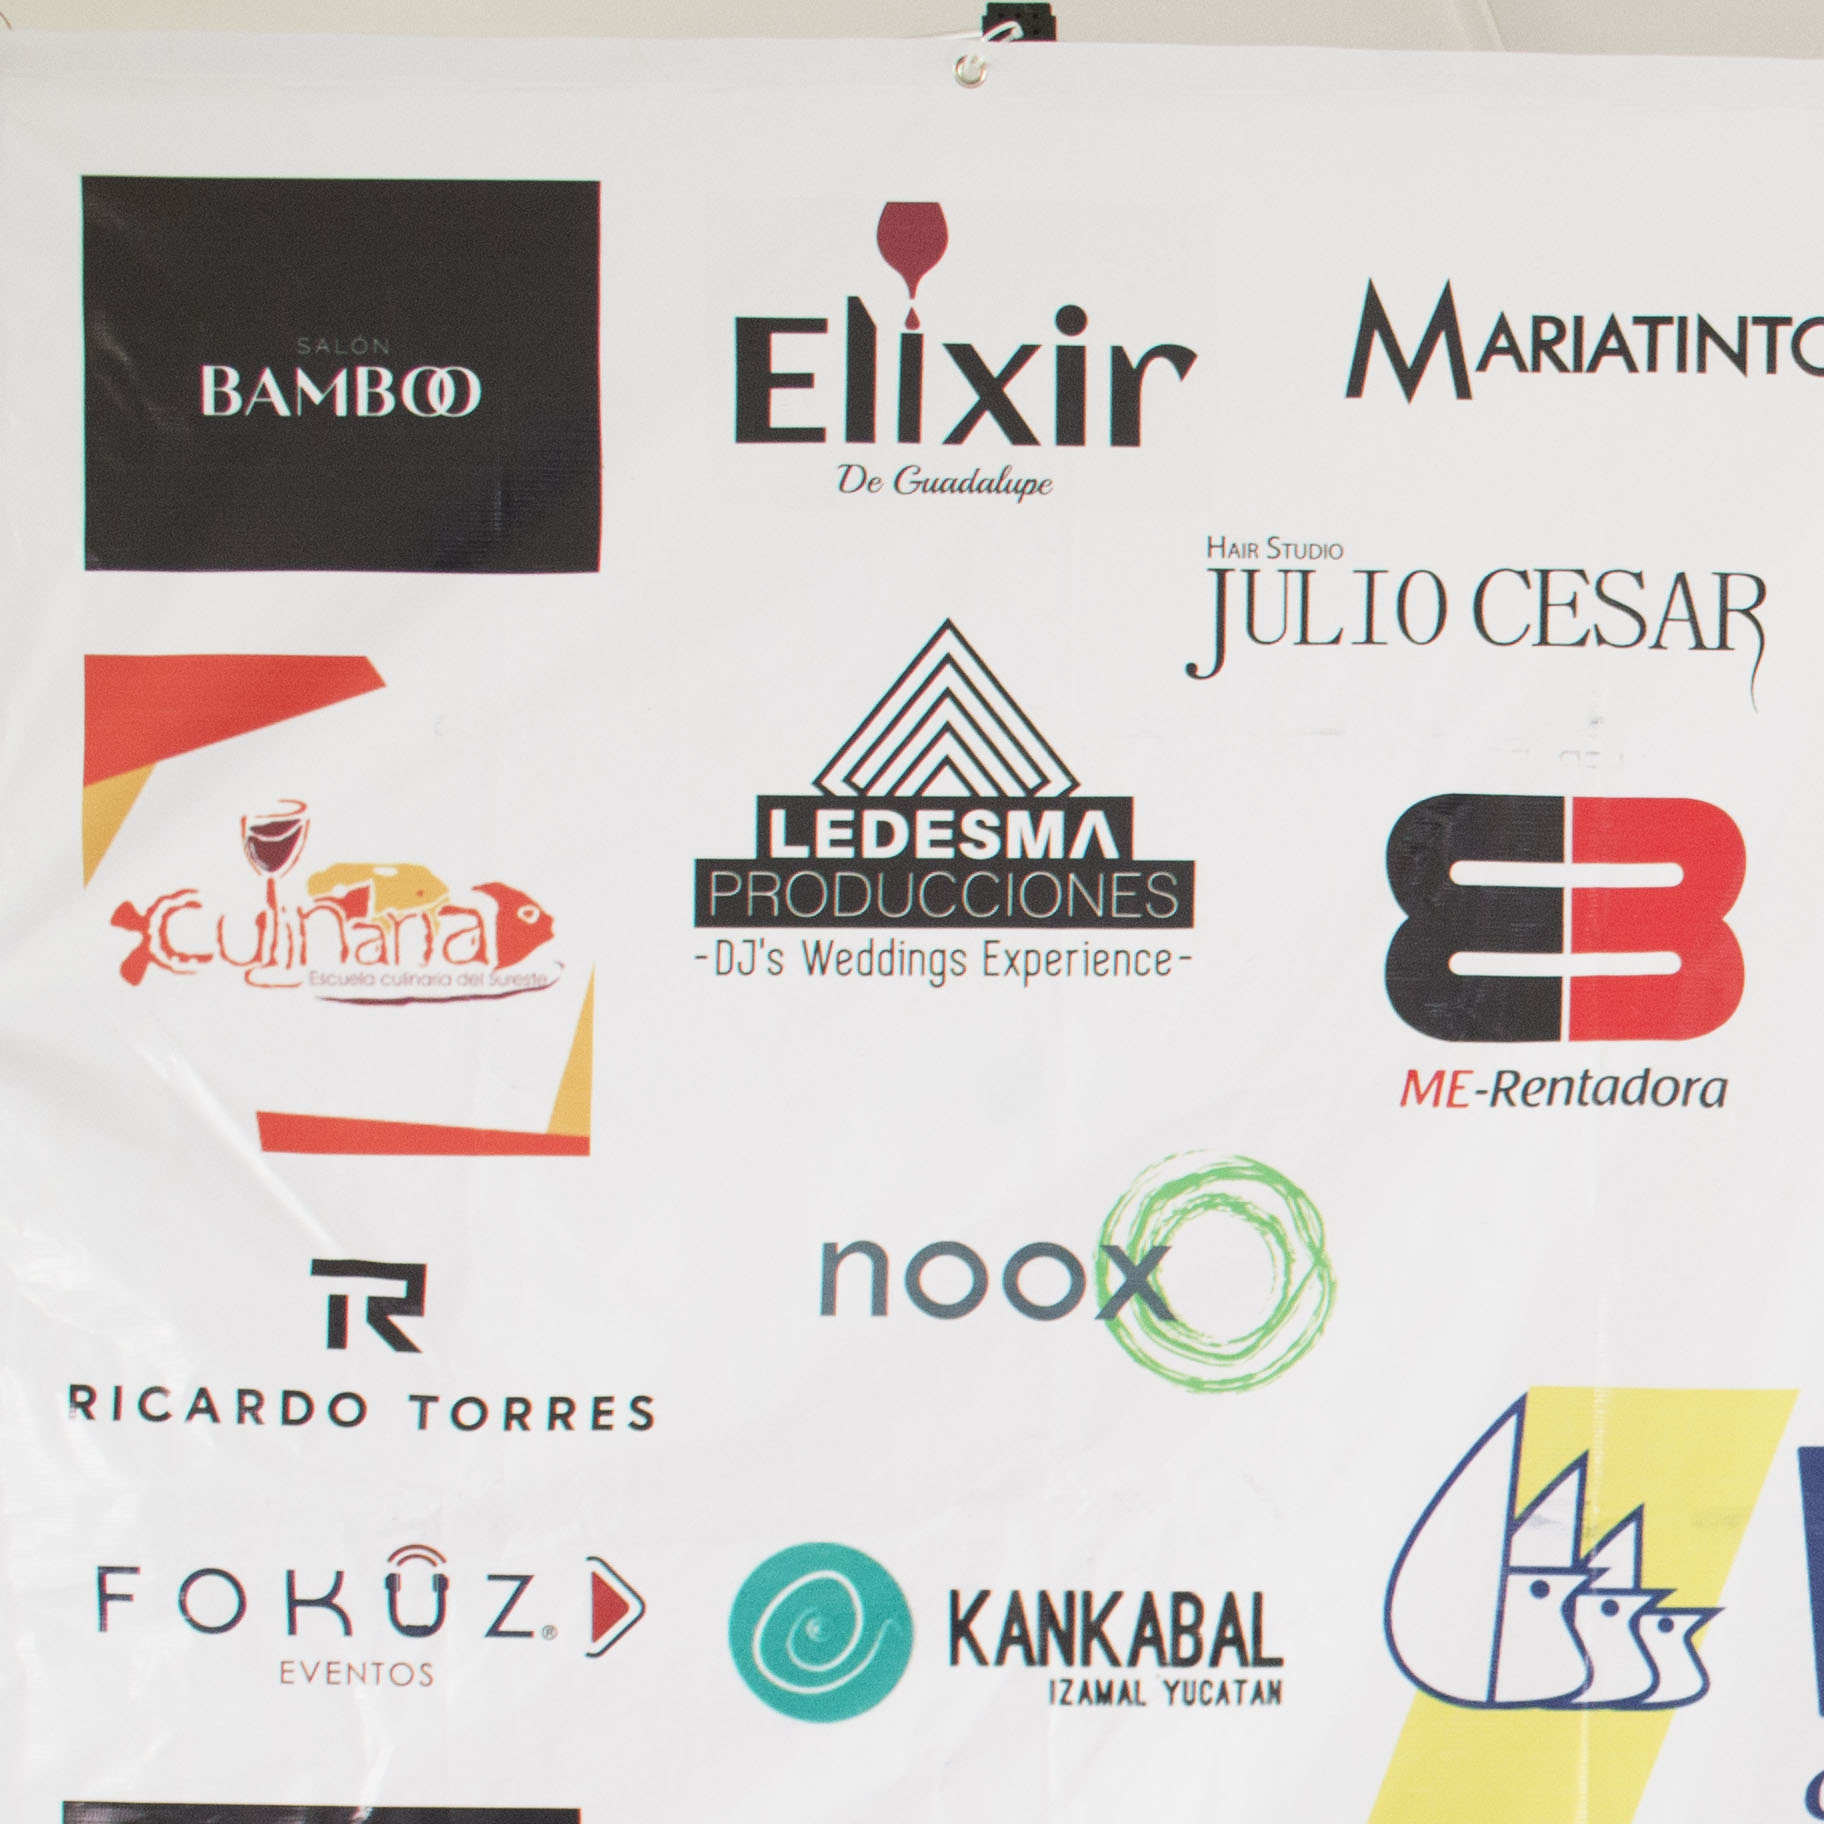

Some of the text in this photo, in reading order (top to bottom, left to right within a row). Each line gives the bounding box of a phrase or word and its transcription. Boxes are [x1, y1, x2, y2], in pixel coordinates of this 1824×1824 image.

[298, 332, 391, 354] SALÓN
[201, 365, 481, 417] BAMBOO
[734, 295, 1198, 447] Elixir
[838, 464, 1052, 503] De Guadalupe
[1185, 568, 1767, 714] JULIO CESAR
[768, 807, 1120, 860] LEDESMA
[710, 870, 1178, 918] PRODUCCIONES
[309, 970, 548, 987] Escuela culinaria del Sureste
[801, 938, 967, 985] Weddings
[1400, 1068, 1728, 1108] ME-Rentadora
[68, 1384, 654, 1431] RICARDO TORRES
[949, 1589, 1284, 1668] KANKABAL
[280, 1660, 434, 1690] EVENTOS
[1047, 1679, 1285, 1707] IZAMAL YUCATAN
